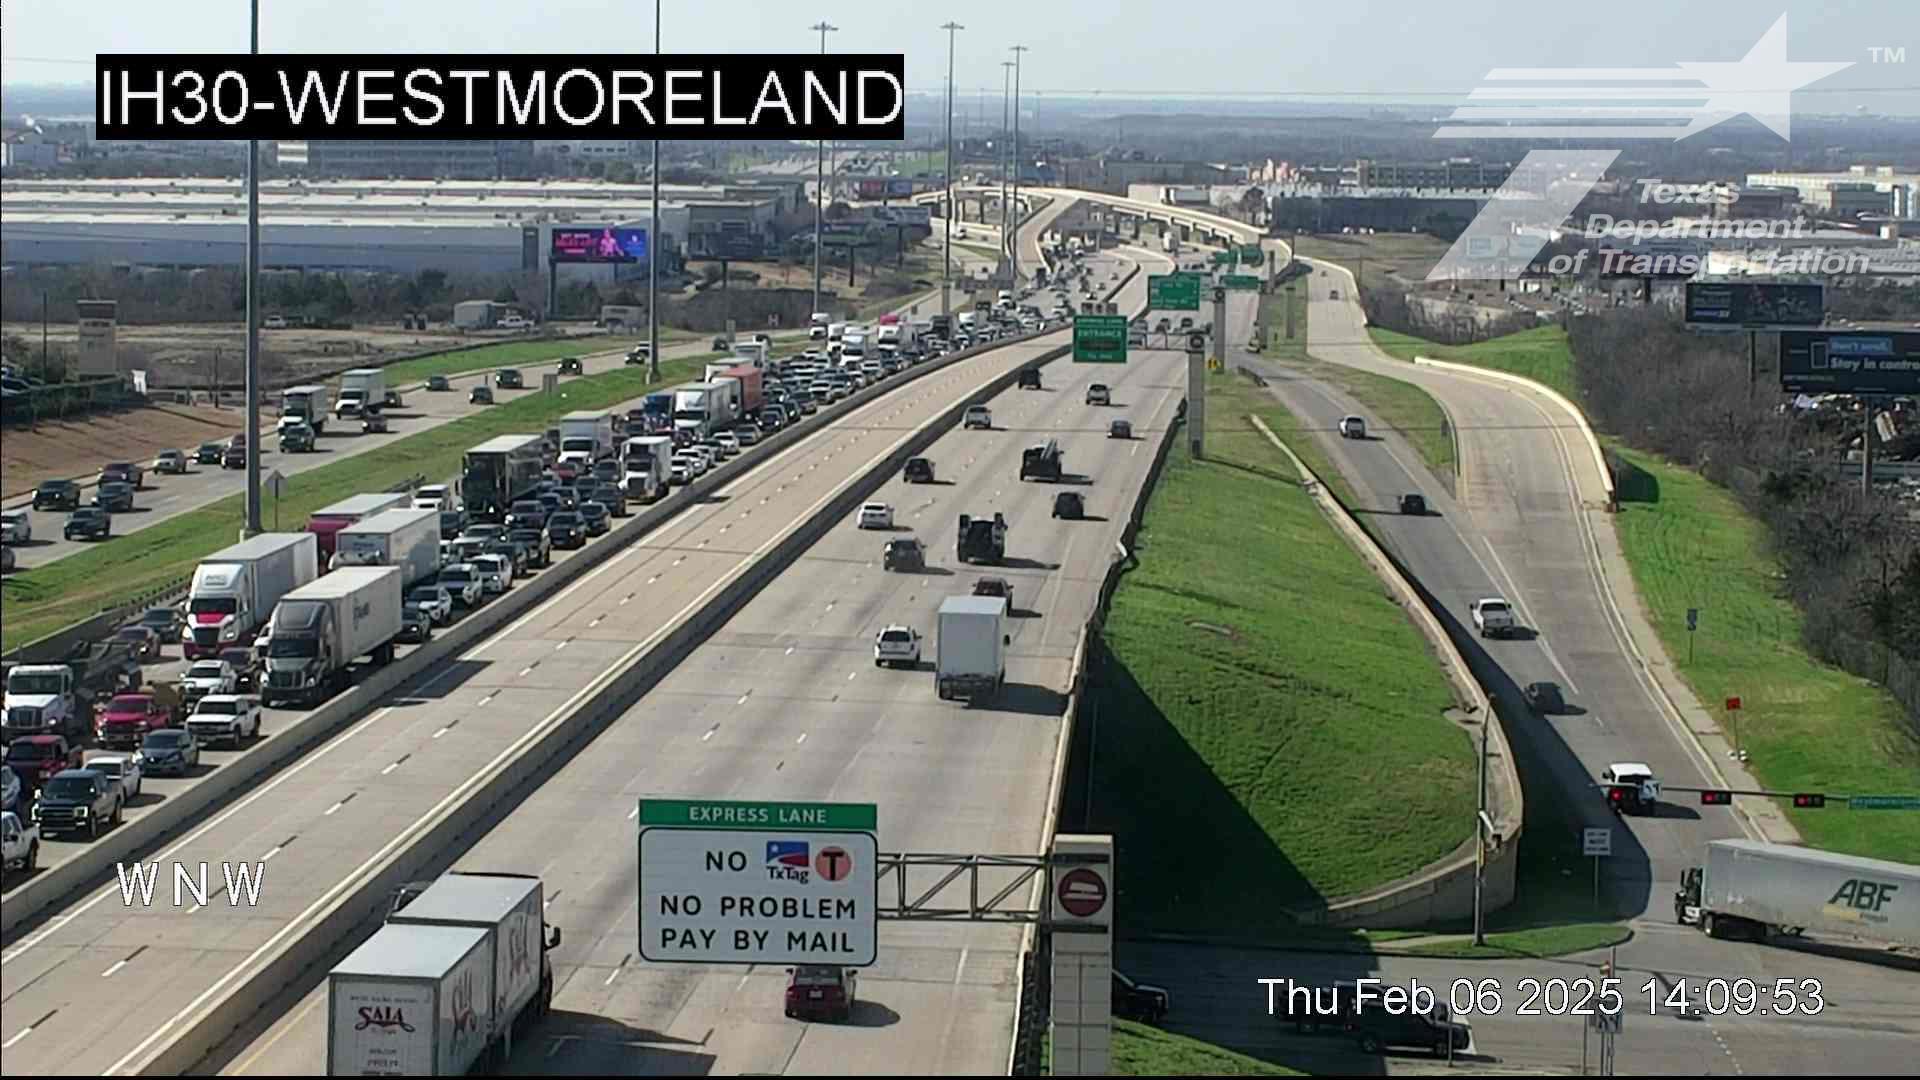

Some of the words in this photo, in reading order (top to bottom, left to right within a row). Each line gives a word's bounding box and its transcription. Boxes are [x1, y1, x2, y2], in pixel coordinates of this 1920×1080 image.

[1830, 357, 1861, 373] Stay
[689, 806, 768, 822] EXPRESS
[779, 809, 826, 823] LANE
[706, 850, 747, 872] NO
[766, 865, 810, 884] TxTag
[660, 895, 702, 915] NO
[720, 897, 856, 920] PROBLEM
[1828, 878, 1899, 912] ABF
[661, 928, 716, 950] PAY
[734, 930, 769, 951] BY
[787, 932, 855, 953] MAIL
[355, 1006, 415, 1032] SAIA
